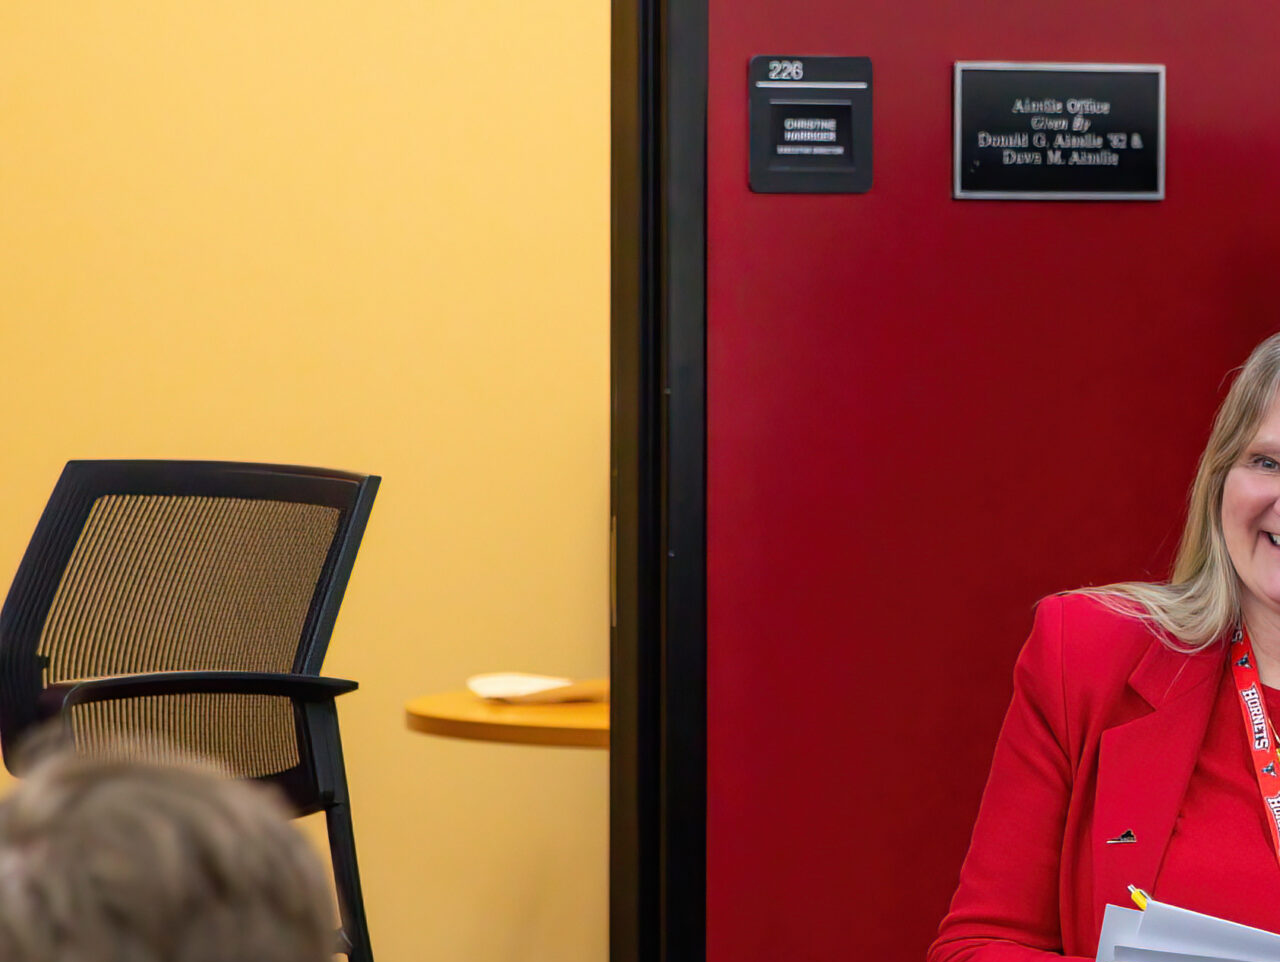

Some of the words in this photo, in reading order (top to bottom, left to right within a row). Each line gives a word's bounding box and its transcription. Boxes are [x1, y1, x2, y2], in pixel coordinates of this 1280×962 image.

[768, 60, 804, 80] 226
[1066, 98, 1111, 115] Office
[1241, 684, 1271, 752] HORNETS
